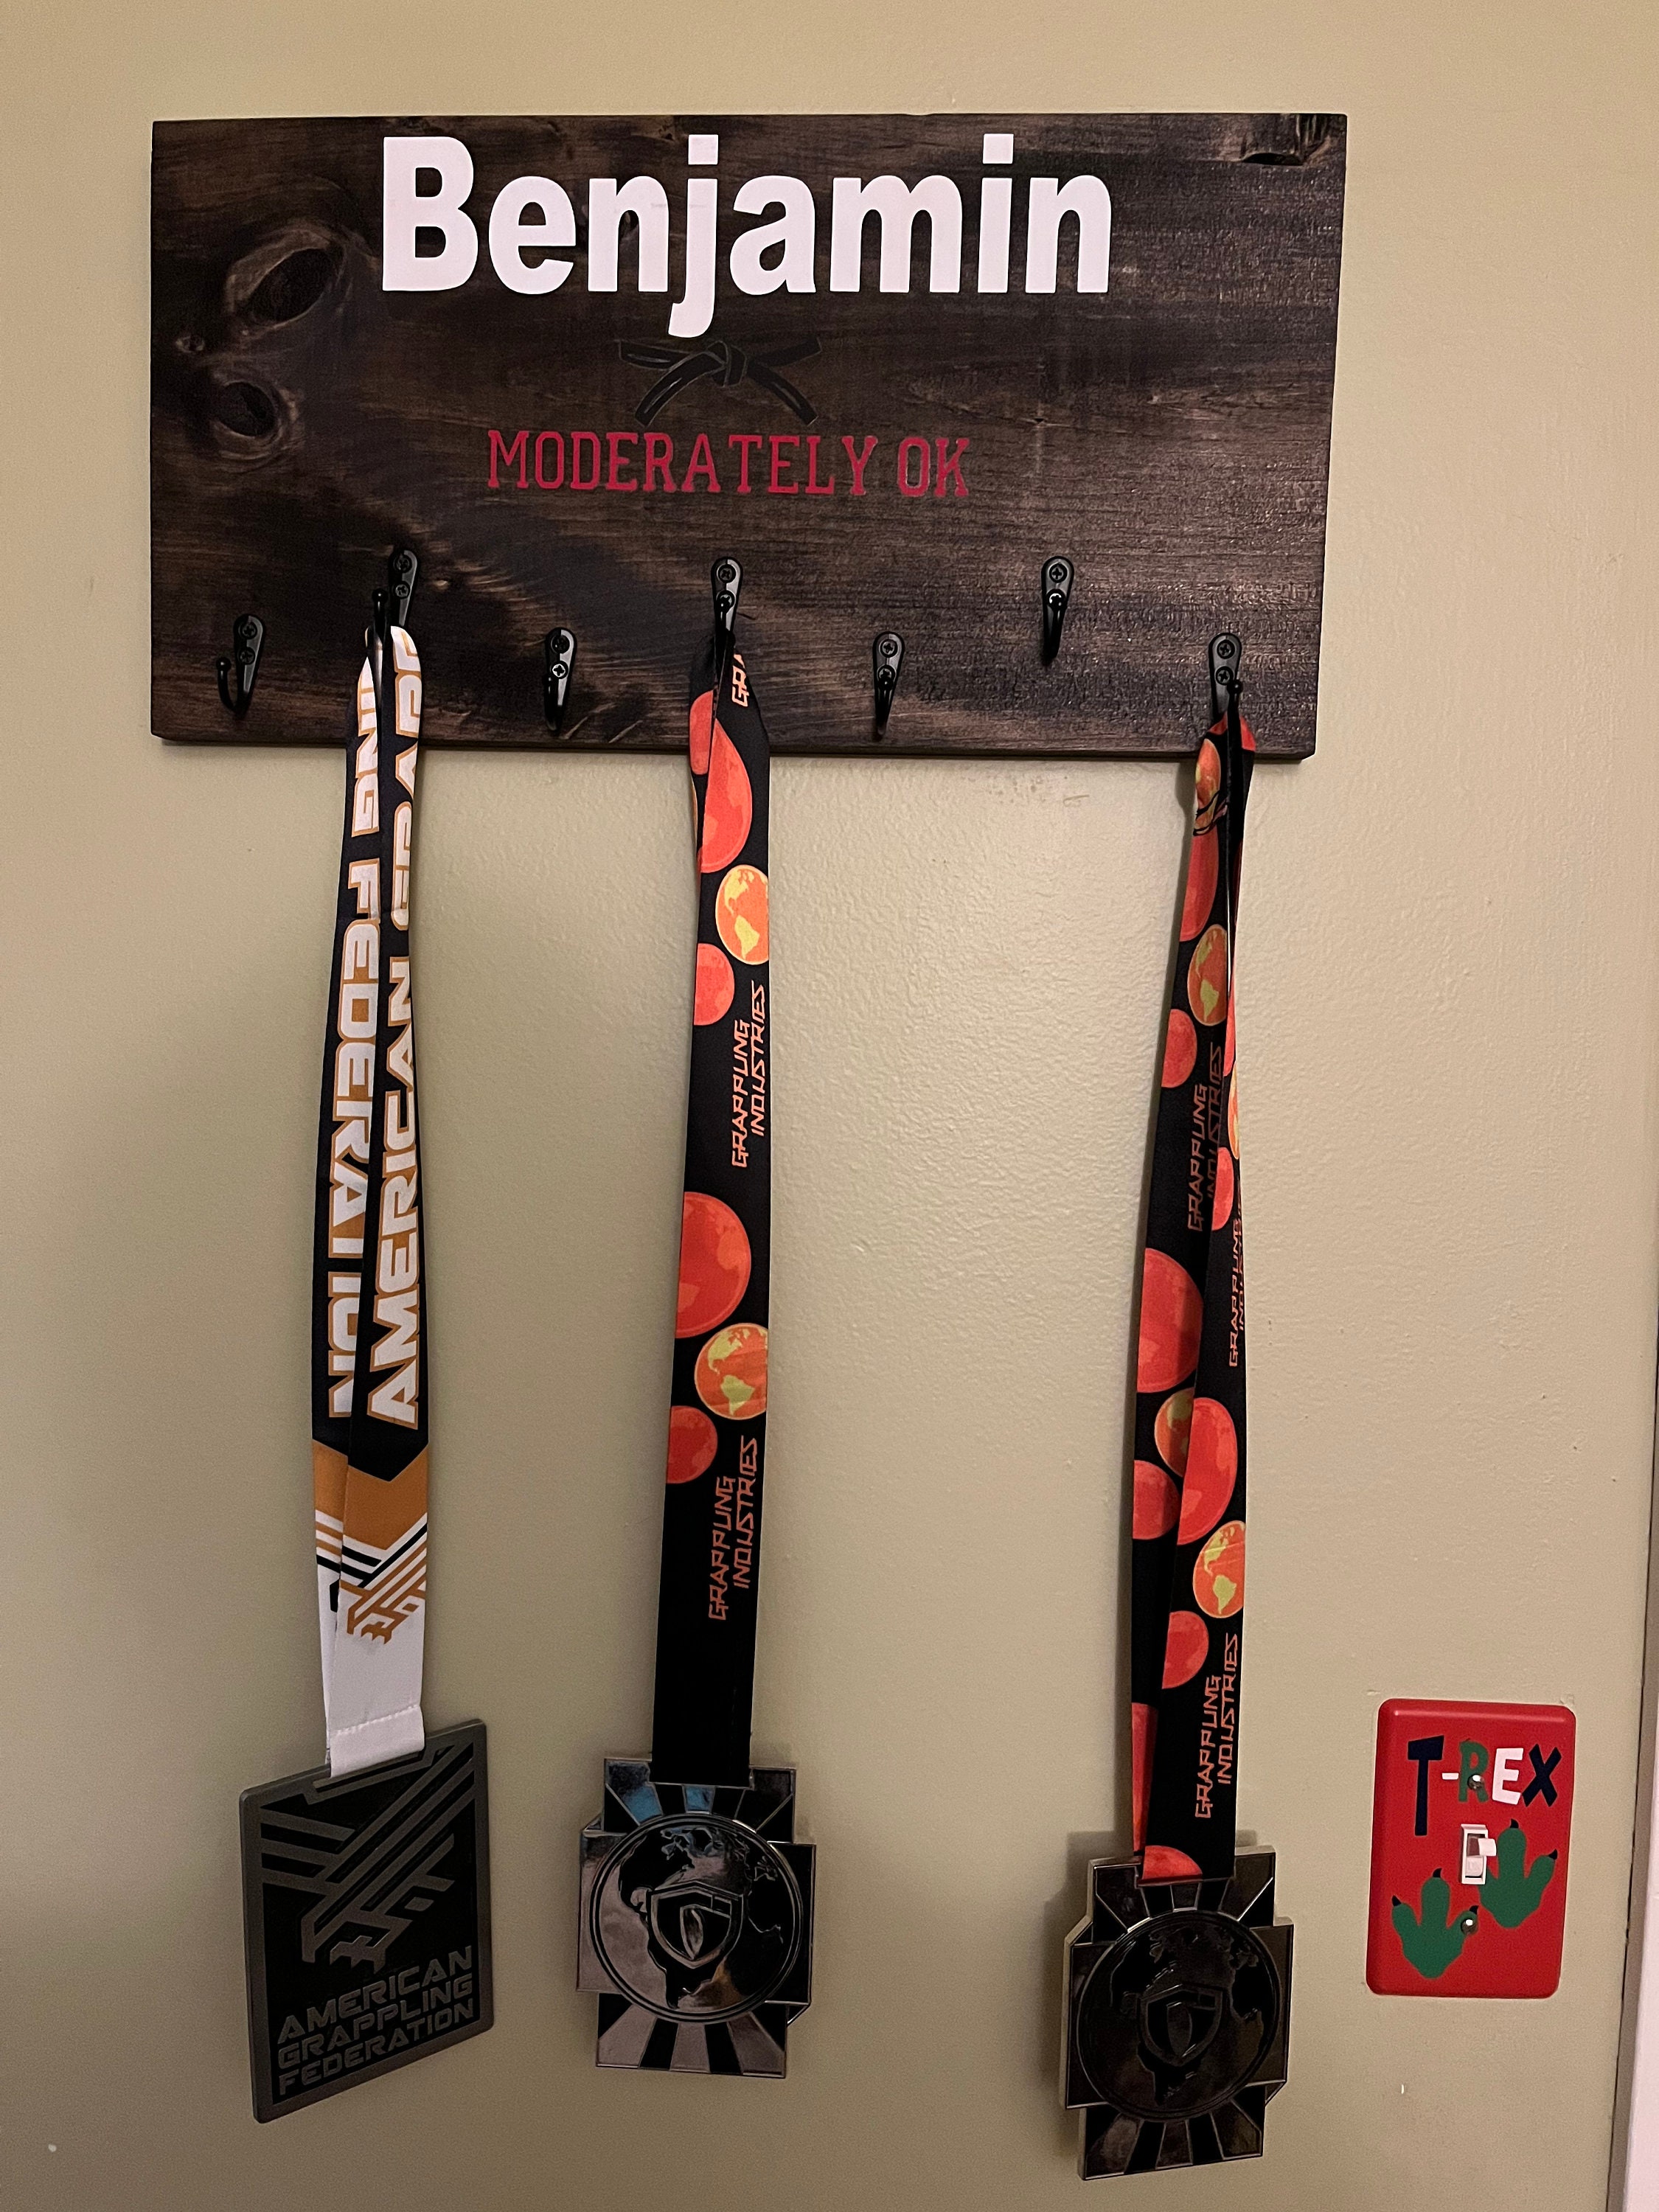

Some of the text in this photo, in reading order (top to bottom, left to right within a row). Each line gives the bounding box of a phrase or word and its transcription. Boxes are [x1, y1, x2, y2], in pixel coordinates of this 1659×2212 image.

[382, 133, 1112, 338] Benjamin
[487, 431, 970, 498] MODERATELY OK
[731, 1019, 751, 1169] GRAPPLING
[751, 979, 765, 1137] INDUSTRIES
[366, 956, 419, 1430] AMERICAN
[708, 1475, 736, 1621] GRAPPLING
[733, 1435, 758, 1589] INDUSTRIES
[1195, 1674, 1222, 1818] GRAPPLING
[1217, 1632, 1238, 1784] INDUSTRIES
[1408, 1735, 1562, 1836] T-REX
[277, 1945, 473, 2045] AMERICAN
[277, 1972, 473, 2070] GRAPPLING
[279, 1997, 474, 2096] FEDERATION
